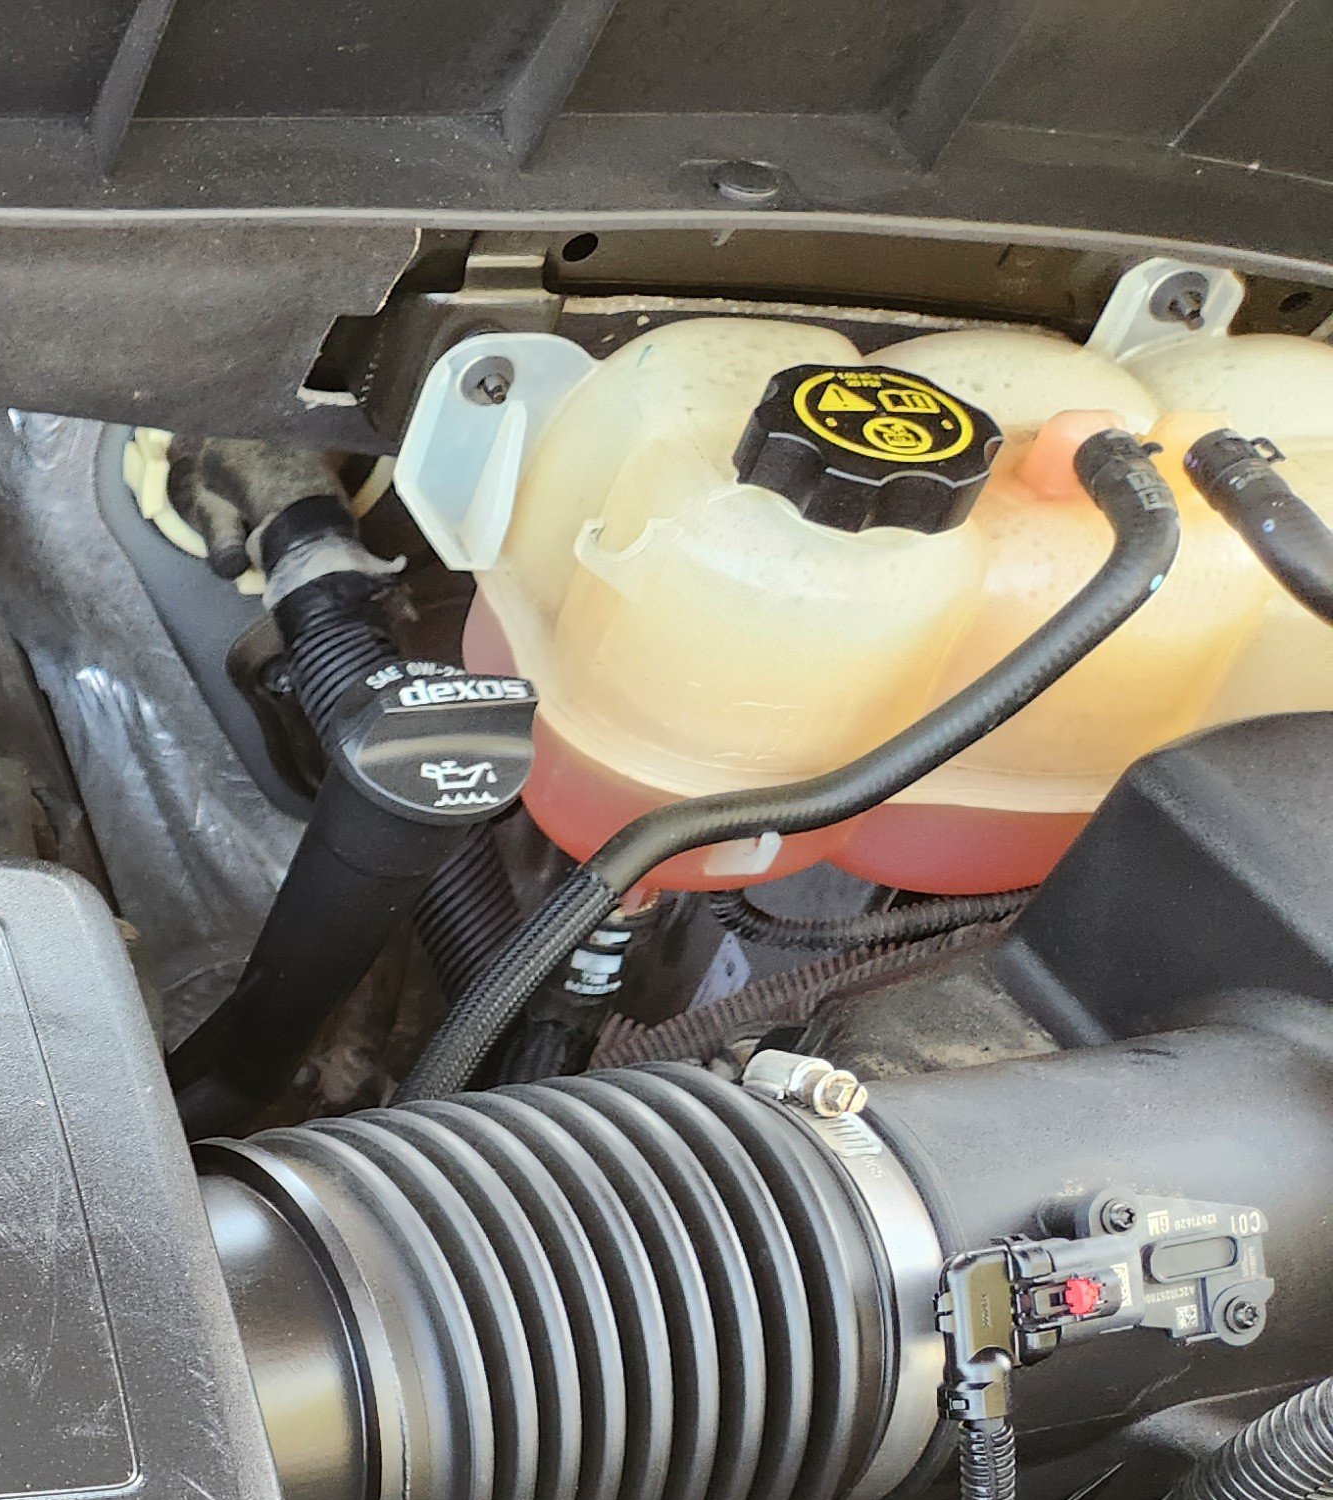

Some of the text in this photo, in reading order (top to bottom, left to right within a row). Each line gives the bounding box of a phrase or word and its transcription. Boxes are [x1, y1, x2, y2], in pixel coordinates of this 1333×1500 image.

[365, 665, 404, 690] SAE
[398, 679, 529, 708] dexos
[1147, 1210, 1170, 1237] GM
